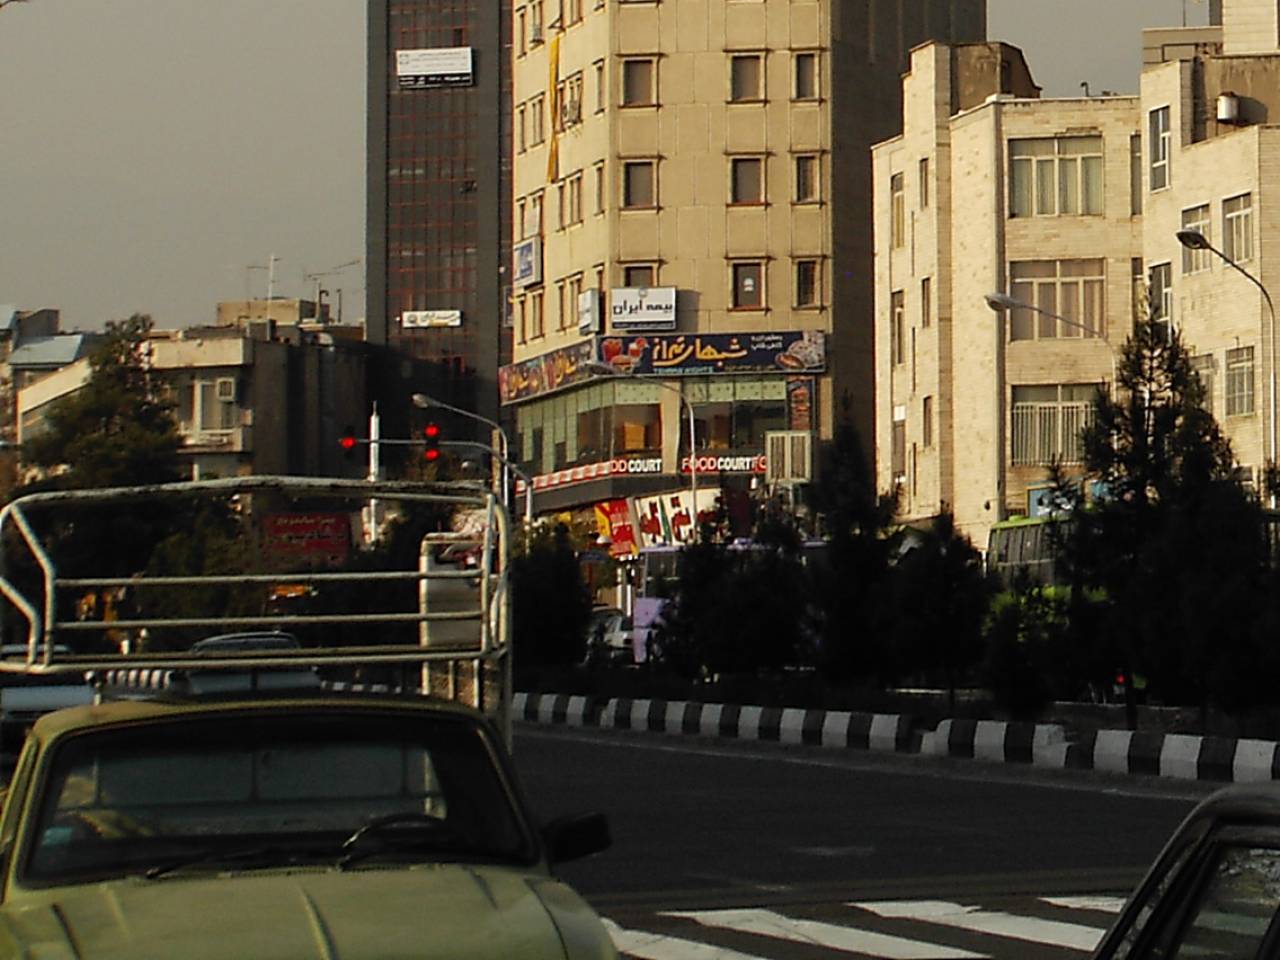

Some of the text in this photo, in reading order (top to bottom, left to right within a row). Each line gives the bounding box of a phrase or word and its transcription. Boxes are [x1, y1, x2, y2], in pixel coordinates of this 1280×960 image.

[613, 299, 643, 316] ایران
[628, 459, 663, 473] COURT
[682, 456, 717, 472] FOOD
[717, 456, 752, 471] COURT
